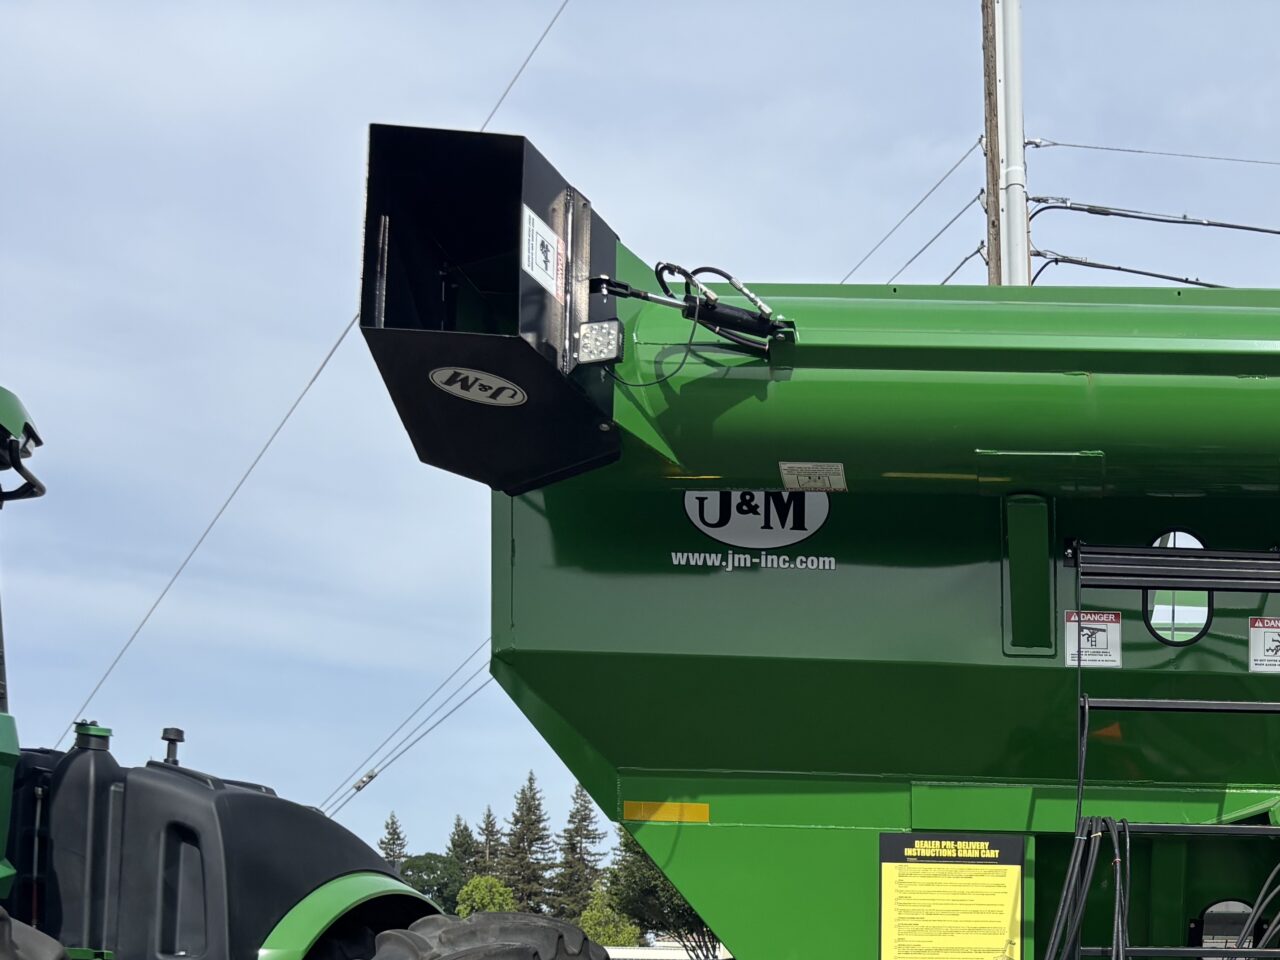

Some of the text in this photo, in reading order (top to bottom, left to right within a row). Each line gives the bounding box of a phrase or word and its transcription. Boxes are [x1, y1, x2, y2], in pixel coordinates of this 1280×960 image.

[441, 371, 518, 400] J&M
[695, 491, 808, 531] J&M
[671, 550, 836, 572] www.jm-inc.com
[1081, 613, 1116, 621] DANGER
[914, 840, 990, 850] DEALER PRE-DELIVERY
[904, 848, 1000, 859] INSTRUCTIONS GRAIN CART
